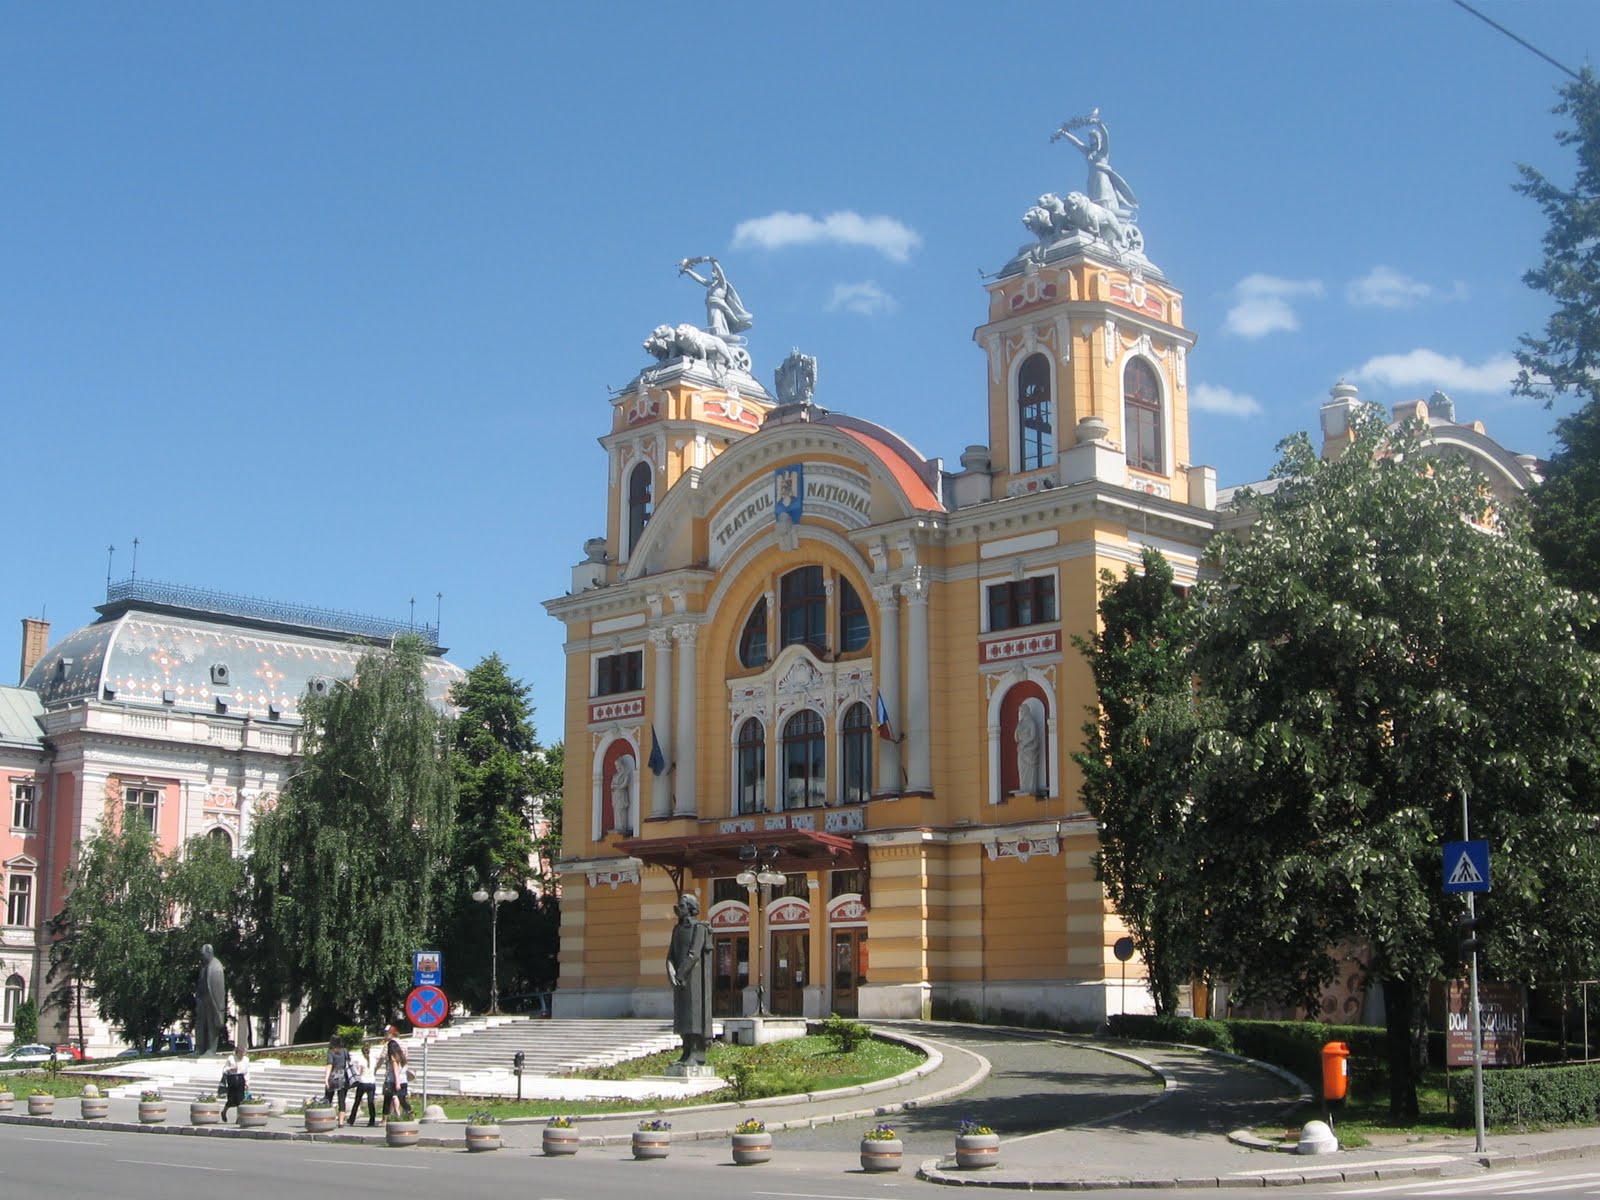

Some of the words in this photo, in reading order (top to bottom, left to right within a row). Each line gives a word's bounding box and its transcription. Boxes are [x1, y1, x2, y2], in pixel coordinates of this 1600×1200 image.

[716, 493, 774, 546] TEATRUL
[1448, 1012, 1468, 1031] DON
[1481, 1013, 1517, 1031] SQUALE
